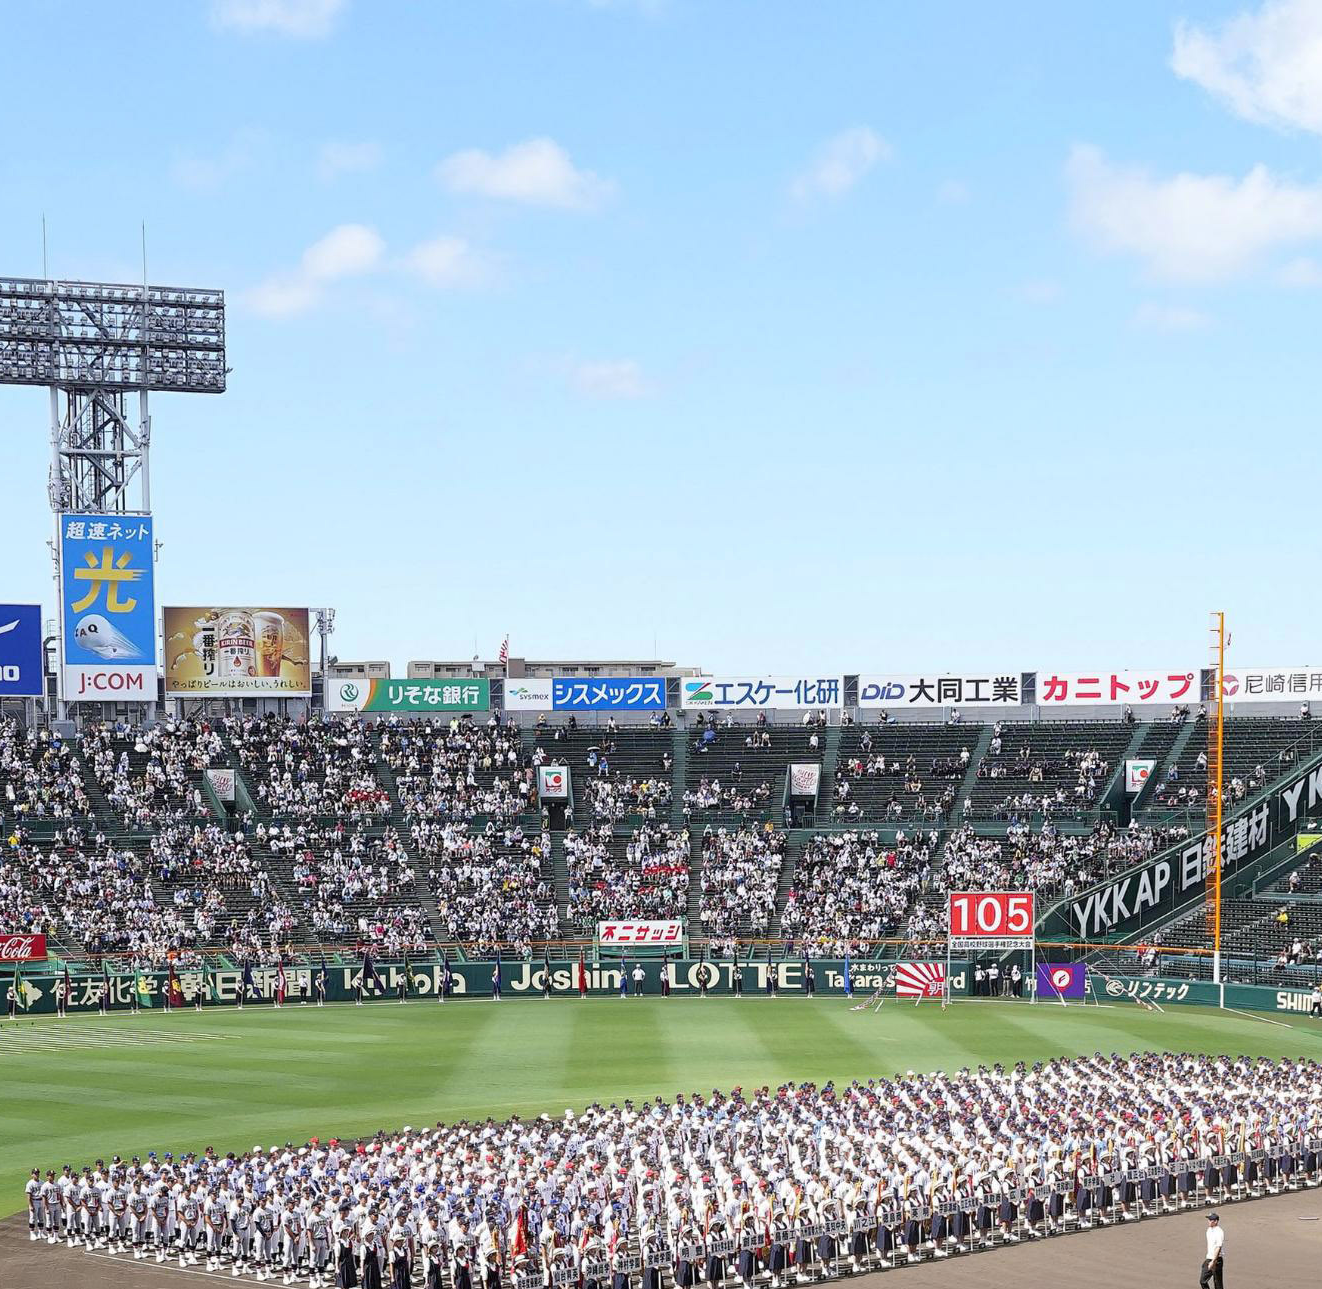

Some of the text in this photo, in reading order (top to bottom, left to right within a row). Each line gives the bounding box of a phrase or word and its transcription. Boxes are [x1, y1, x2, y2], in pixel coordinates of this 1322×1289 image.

[66, 521, 149, 541] 超速ネット
[71, 546, 145, 614] 光
[202, 627, 216, 676] 一番搾り
[78, 673, 143, 694] J:COM
[172, 680, 306, 689] やっぱりビールはおいしい、うれしい。
[388, 684, 480, 704] りそな銀行
[555, 683, 662, 705] シスメックス
[714, 679, 839, 704] エスケー化研
[909, 677, 1019, 703] 大同工業
[1043, 673, 1194, 701] カニトップ
[519, 692, 549, 701] sysmex
[1072, 860, 1171, 939] YKK AP
[954, 897, 1030, 932] 105
[601, 925, 681, 942] 不二サッシ
[952, 940, 1031, 949] 全国高校野球選手権記念大会
[180, 969, 312, 1001] 朝日新聞
[511, 963, 621, 990] Joshin
[666, 962, 802, 989] LOTTE
[825, 971, 884, 988] Takara
[1127, 979, 1188, 1000] リンテック
